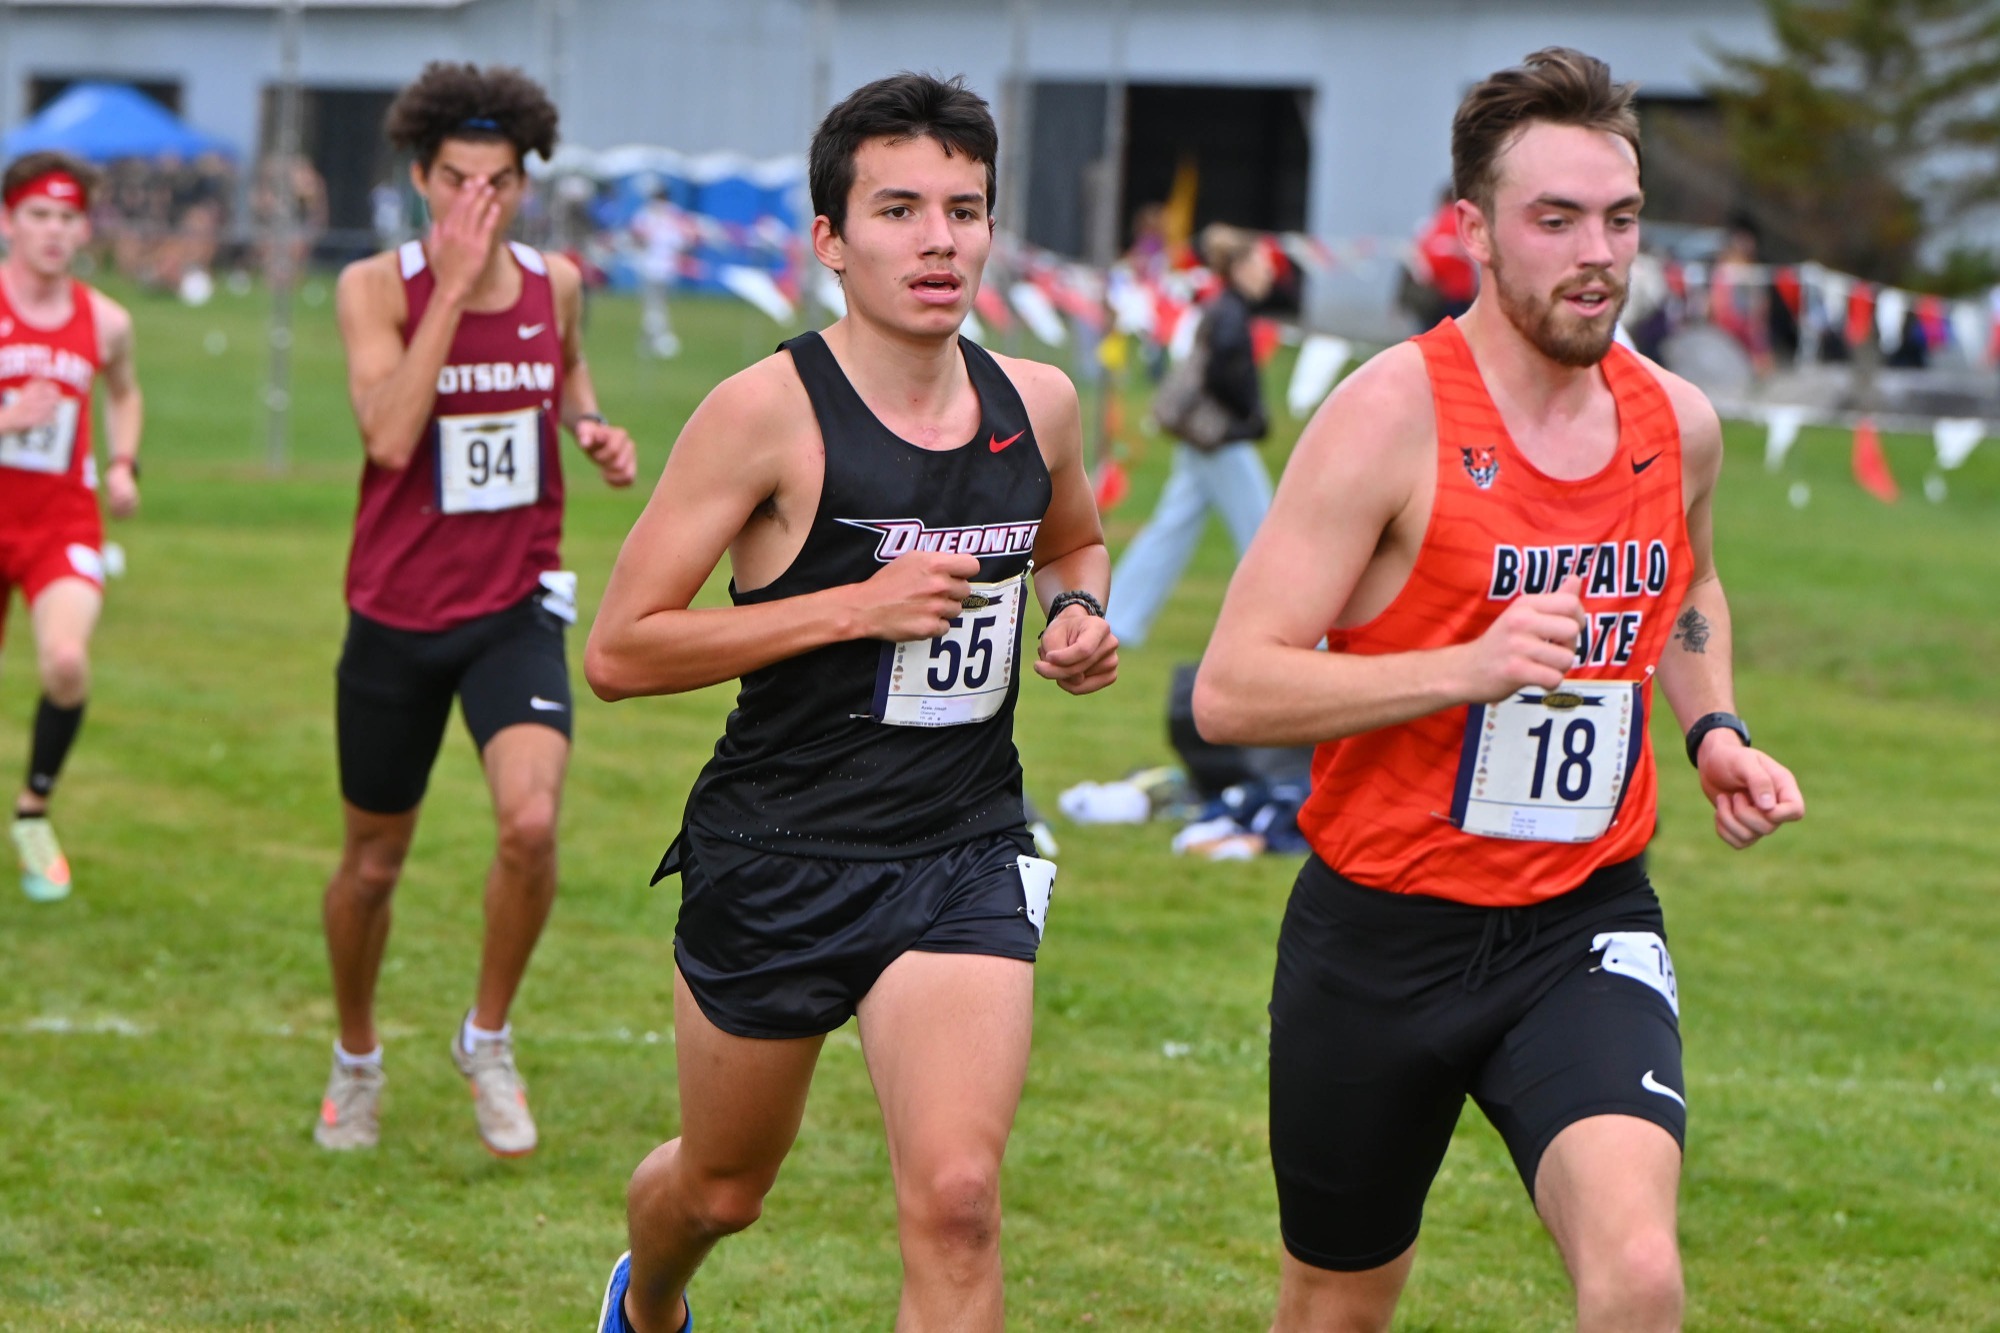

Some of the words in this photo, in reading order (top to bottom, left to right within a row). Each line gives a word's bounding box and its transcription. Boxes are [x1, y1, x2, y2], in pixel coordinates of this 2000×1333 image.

[437, 362, 554, 394] OTSDAM
[467, 437, 517, 488] 94
[1488, 541, 1668, 599] BUFFALO
[926, 615, 997, 692] 55
[1572, 612, 1641, 668] ATE
[1526, 717, 1597, 802] 18
